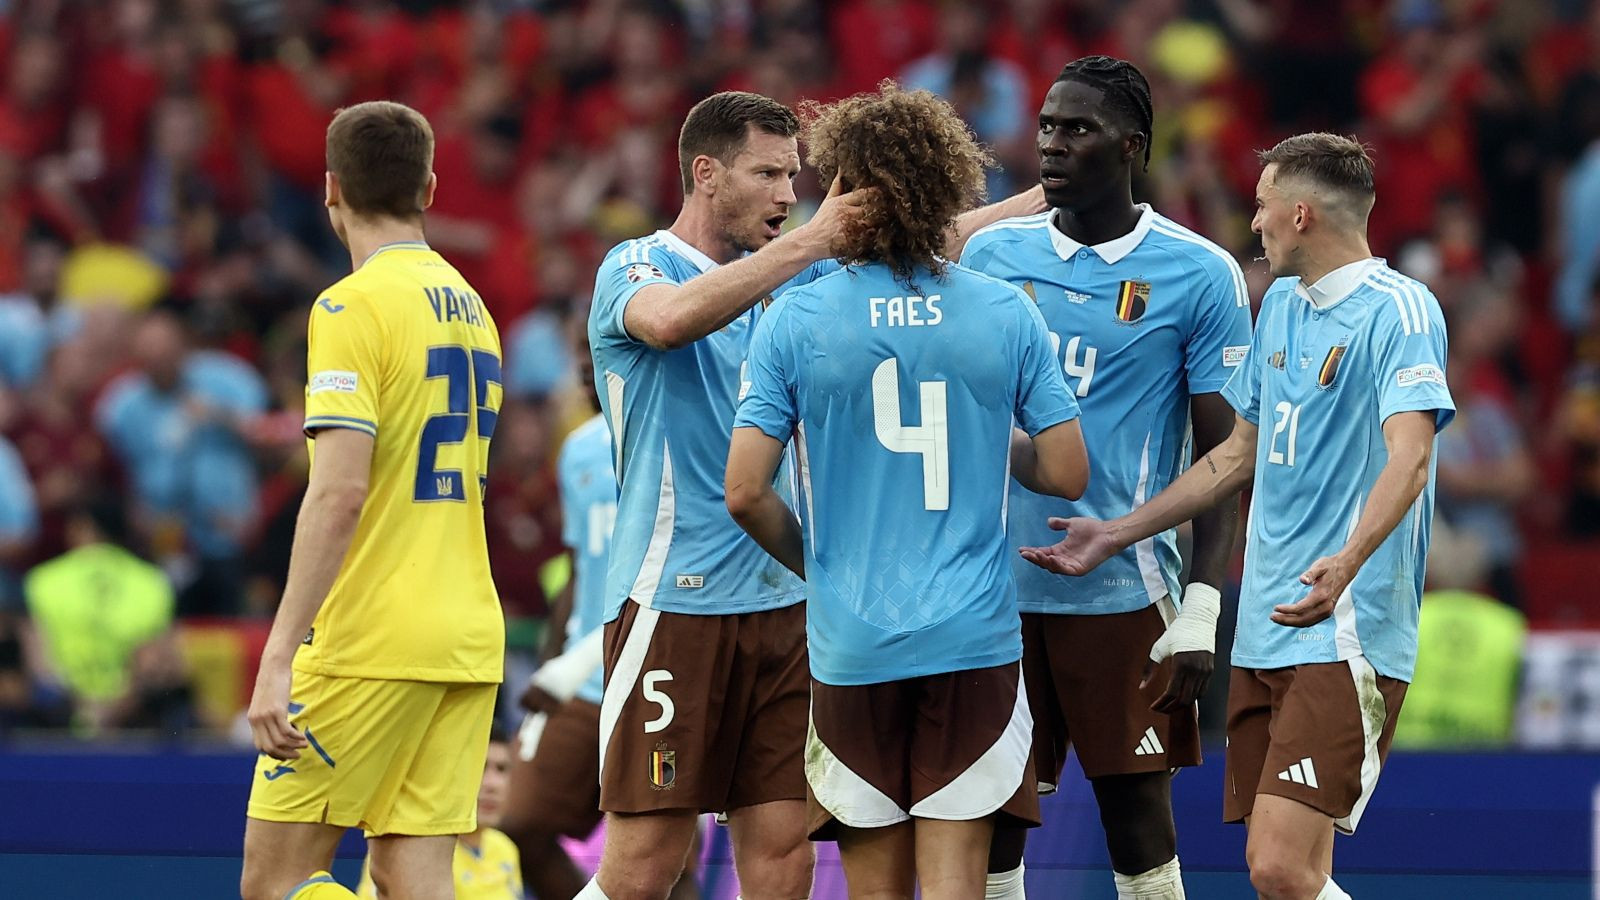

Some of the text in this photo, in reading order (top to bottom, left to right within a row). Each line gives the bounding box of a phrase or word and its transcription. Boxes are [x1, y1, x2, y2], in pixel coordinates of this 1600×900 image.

[869, 294, 943, 327] FAES
[1047, 331, 1098, 398] 4
[412, 344, 503, 503] 25
[872, 357, 949, 510] 4
[1267, 401, 1302, 467] 21
[643, 669, 675, 734] 5
